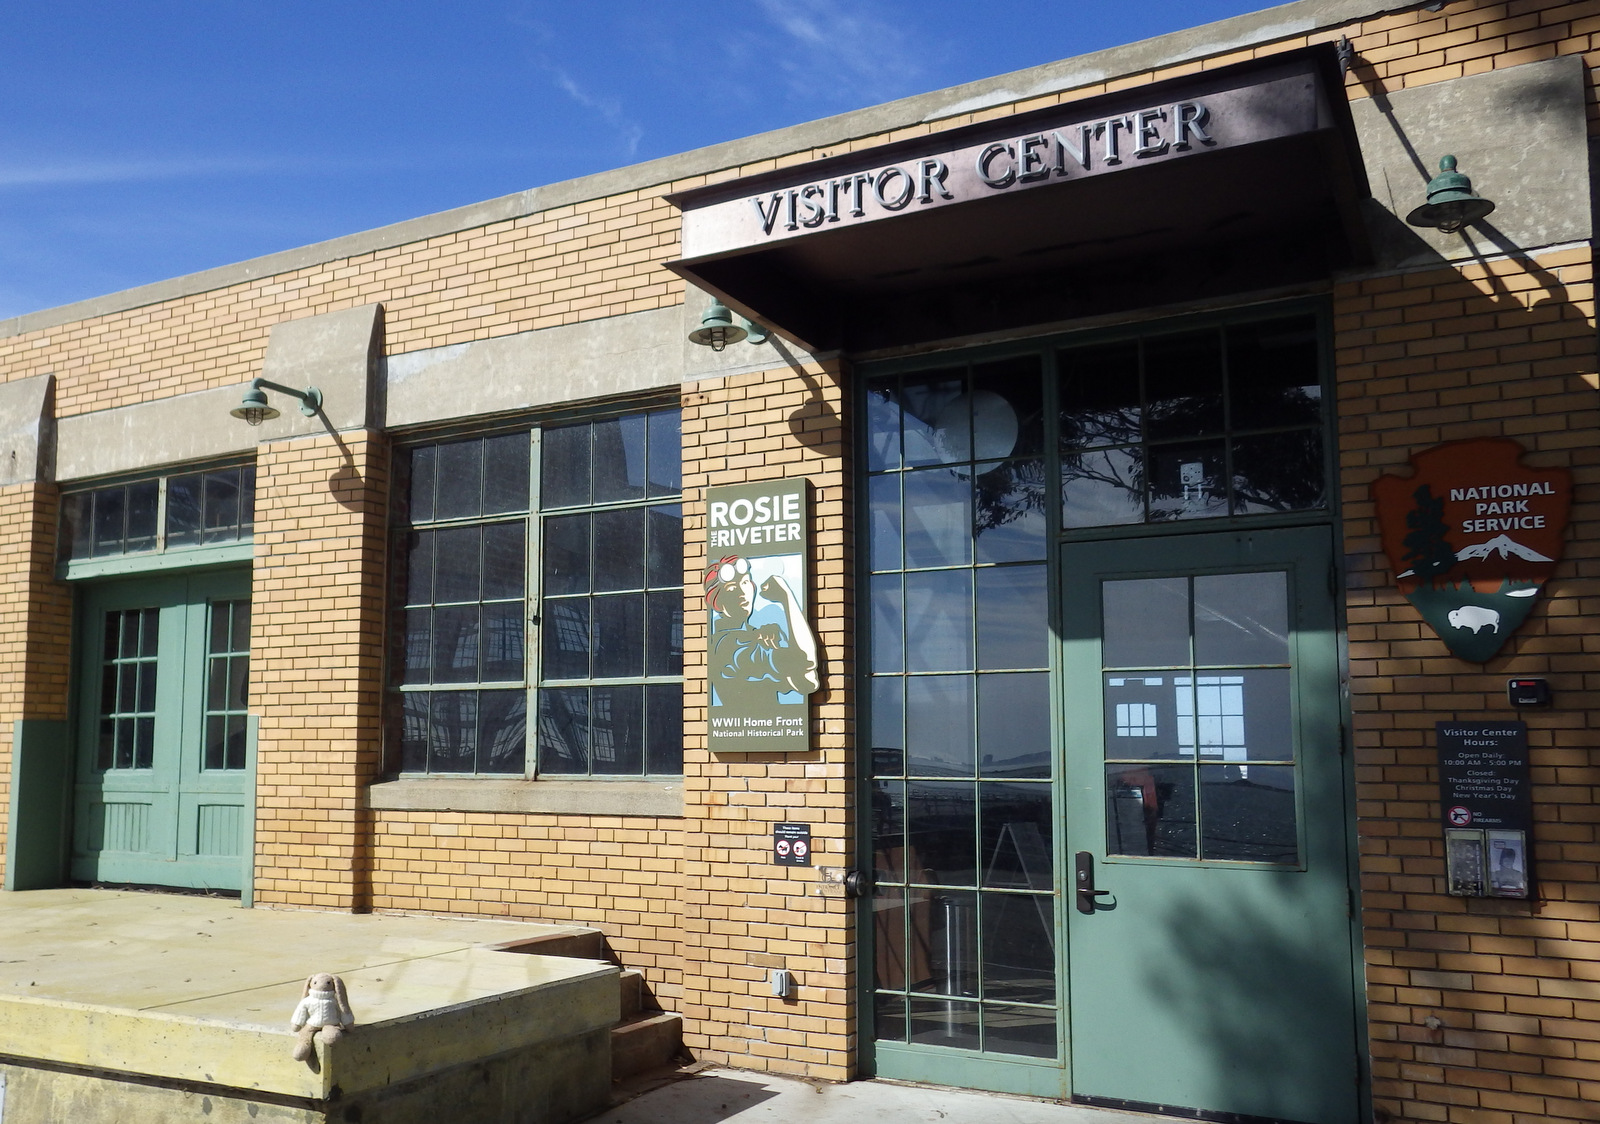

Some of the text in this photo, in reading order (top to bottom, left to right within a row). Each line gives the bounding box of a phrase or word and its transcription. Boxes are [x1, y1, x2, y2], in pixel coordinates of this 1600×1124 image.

[748, 101, 1213, 232] VISITOR CENTER
[1450, 481, 1555, 502] NATIONAL
[710, 493, 800, 528] ROSIE
[1476, 500, 1530, 516] PARK
[1462, 515, 1546, 533] SERVICE
[717, 522, 801, 548] RIVETER
[712, 715, 803, 728] WWII Home Front
[712, 727, 804, 738] National Historical Park
[1443, 728, 1518, 737] Visitor Center
[1448, 777, 1520, 786] Thanksgiving Day
[1497, 785, 1513, 793] Day
